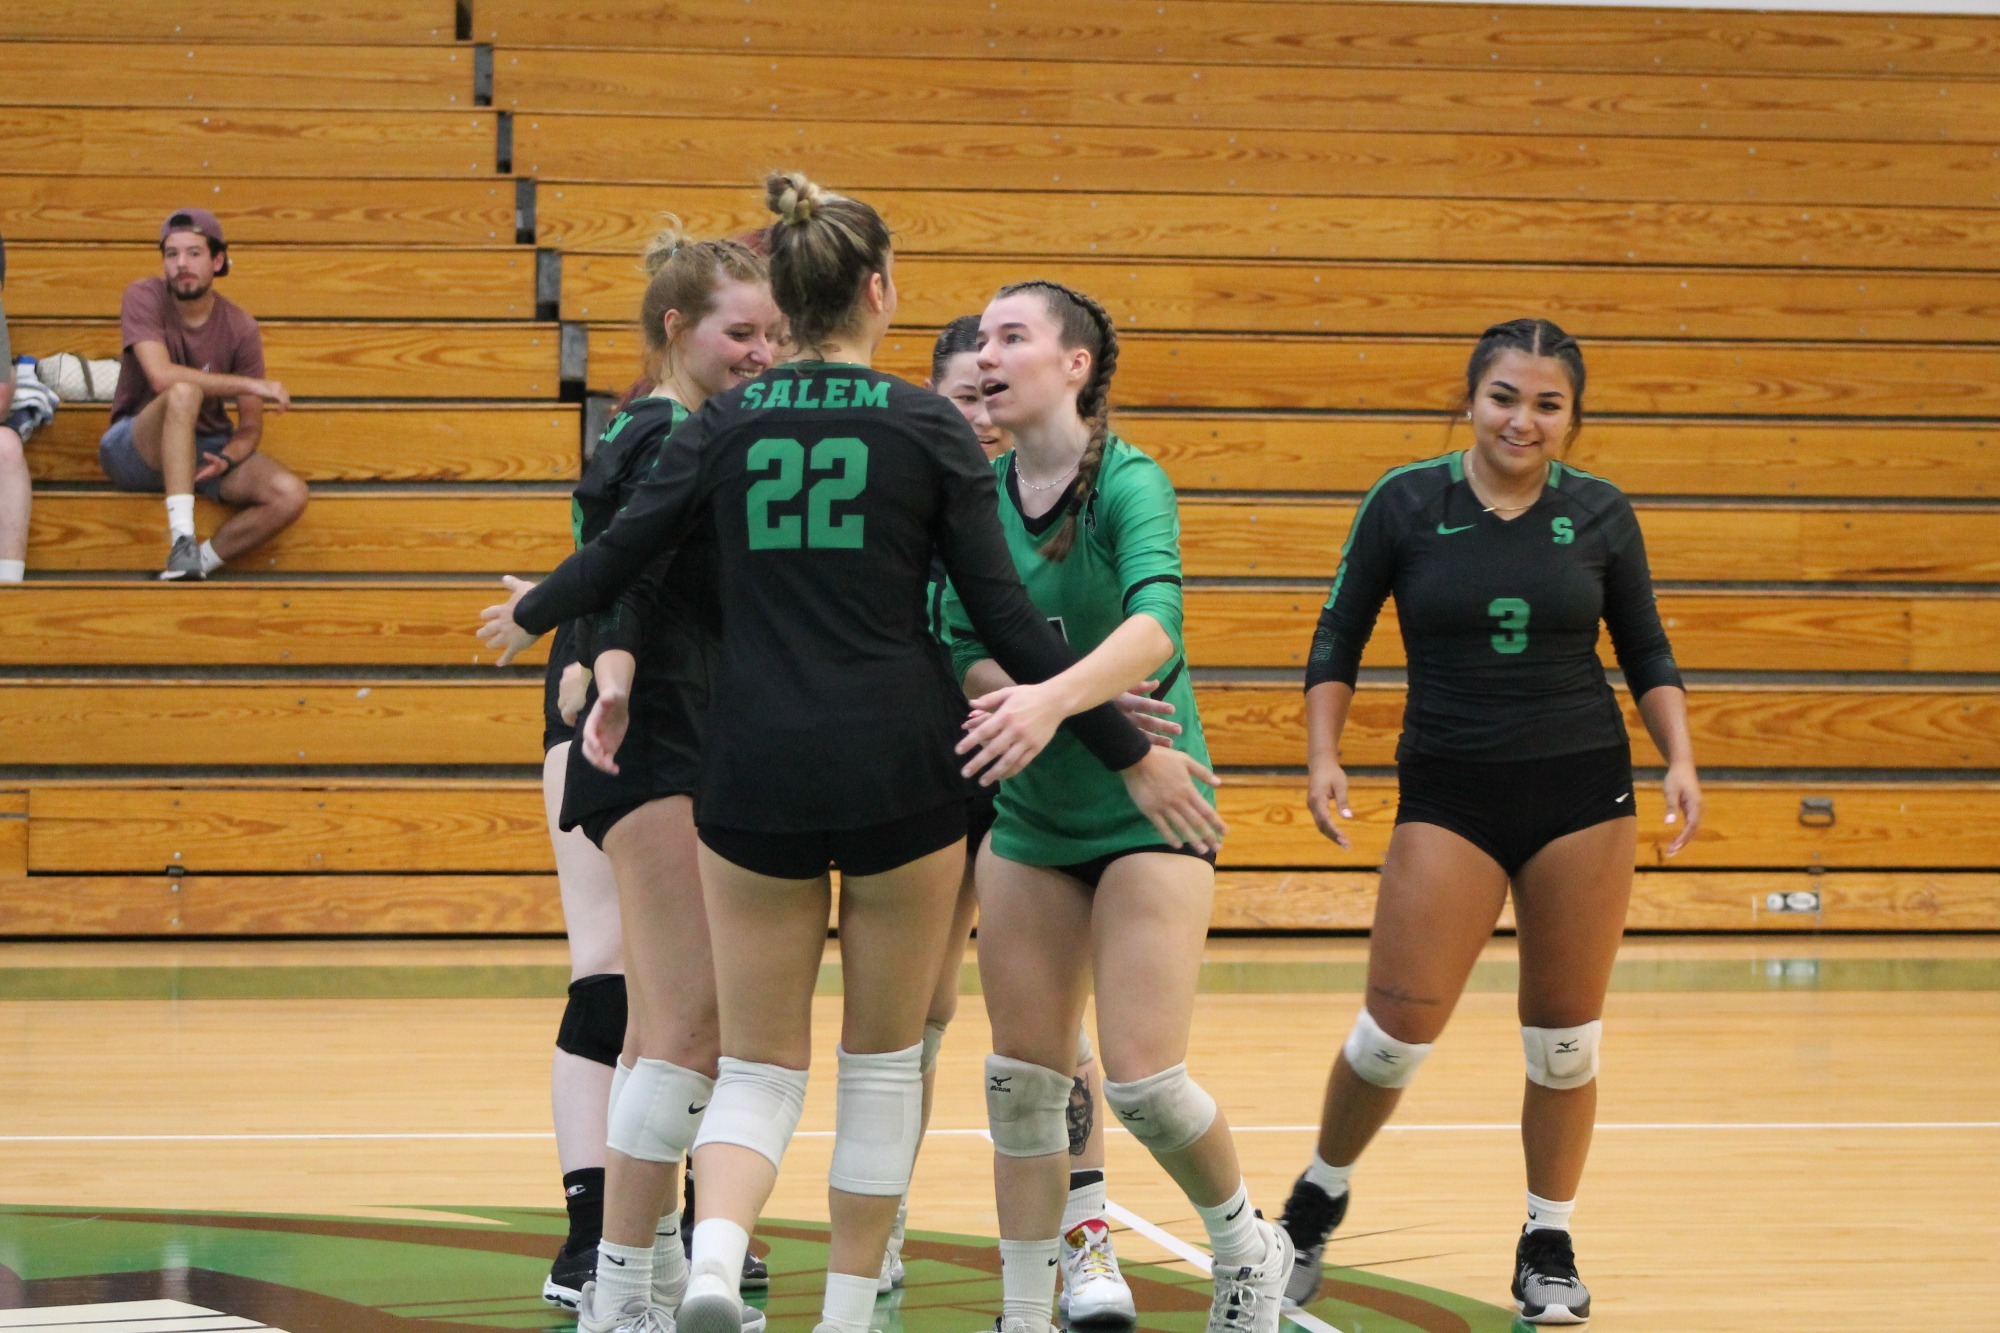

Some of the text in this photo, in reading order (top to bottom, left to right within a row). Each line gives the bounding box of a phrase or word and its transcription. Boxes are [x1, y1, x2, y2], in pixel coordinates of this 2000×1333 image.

[741, 378, 891, 409] SALEM
[746, 437, 869, 550] 22
[1551, 516, 1575, 545] S
[1488, 597, 1530, 654] 3
